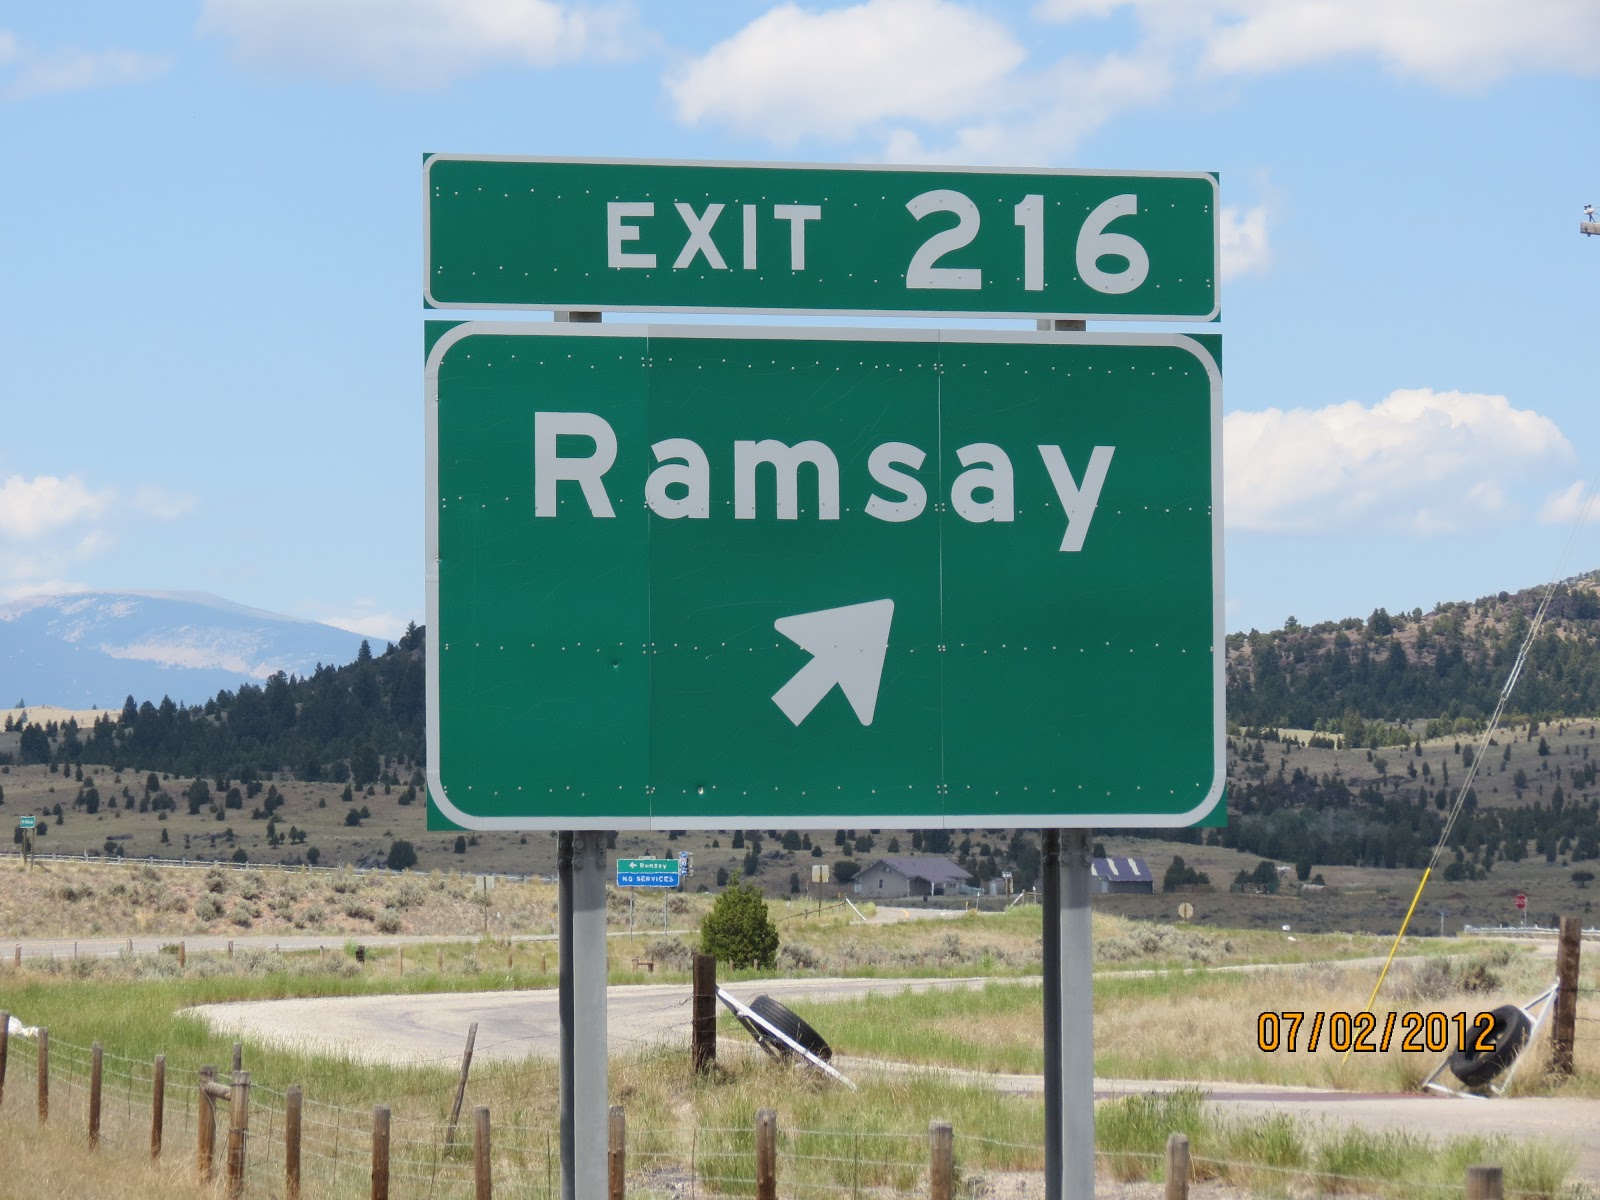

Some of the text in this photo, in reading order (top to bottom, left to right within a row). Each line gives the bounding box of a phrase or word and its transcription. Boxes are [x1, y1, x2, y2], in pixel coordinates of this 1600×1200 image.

[607, 189, 1150, 295] EXIT 216
[534, 411, 1116, 553] Ramsay
[636, 875, 674, 883] SERVICES
